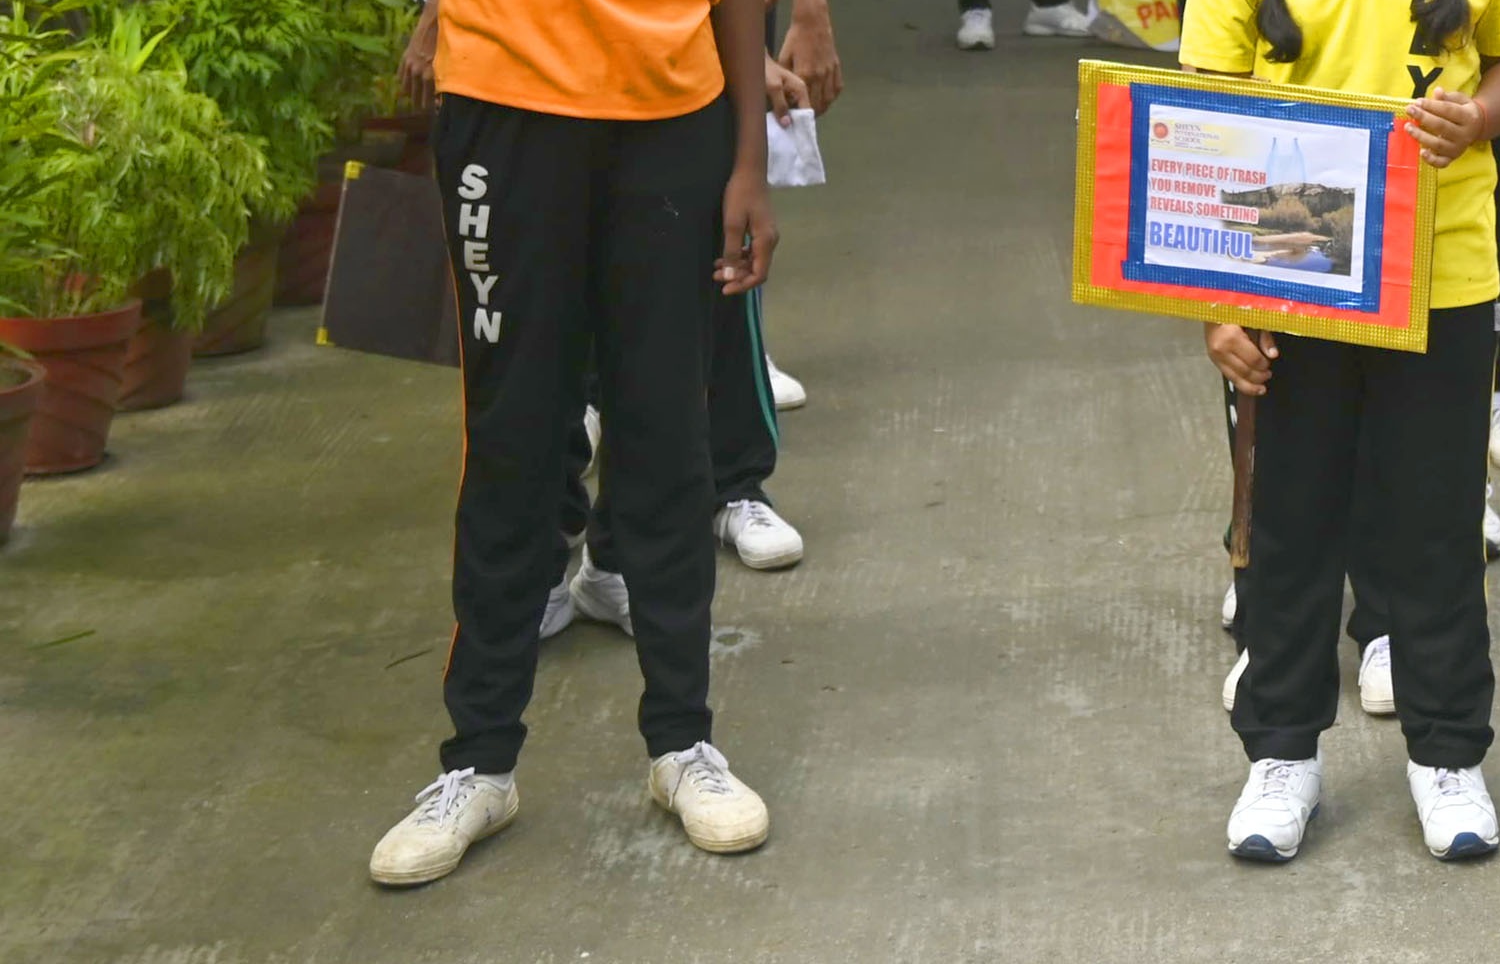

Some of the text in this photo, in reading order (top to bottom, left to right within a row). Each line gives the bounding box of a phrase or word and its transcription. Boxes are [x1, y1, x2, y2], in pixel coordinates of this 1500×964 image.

[1151, 158, 1266, 185] EVERY PIECE OF TRASH
[1151, 178, 1216, 197] YOU REMOVE
[1150, 195, 1258, 222] REVEALS SOMETHING
[456, 162, 503, 345] SHEYN
[1149, 221, 1254, 259] BEAUTIFUL
